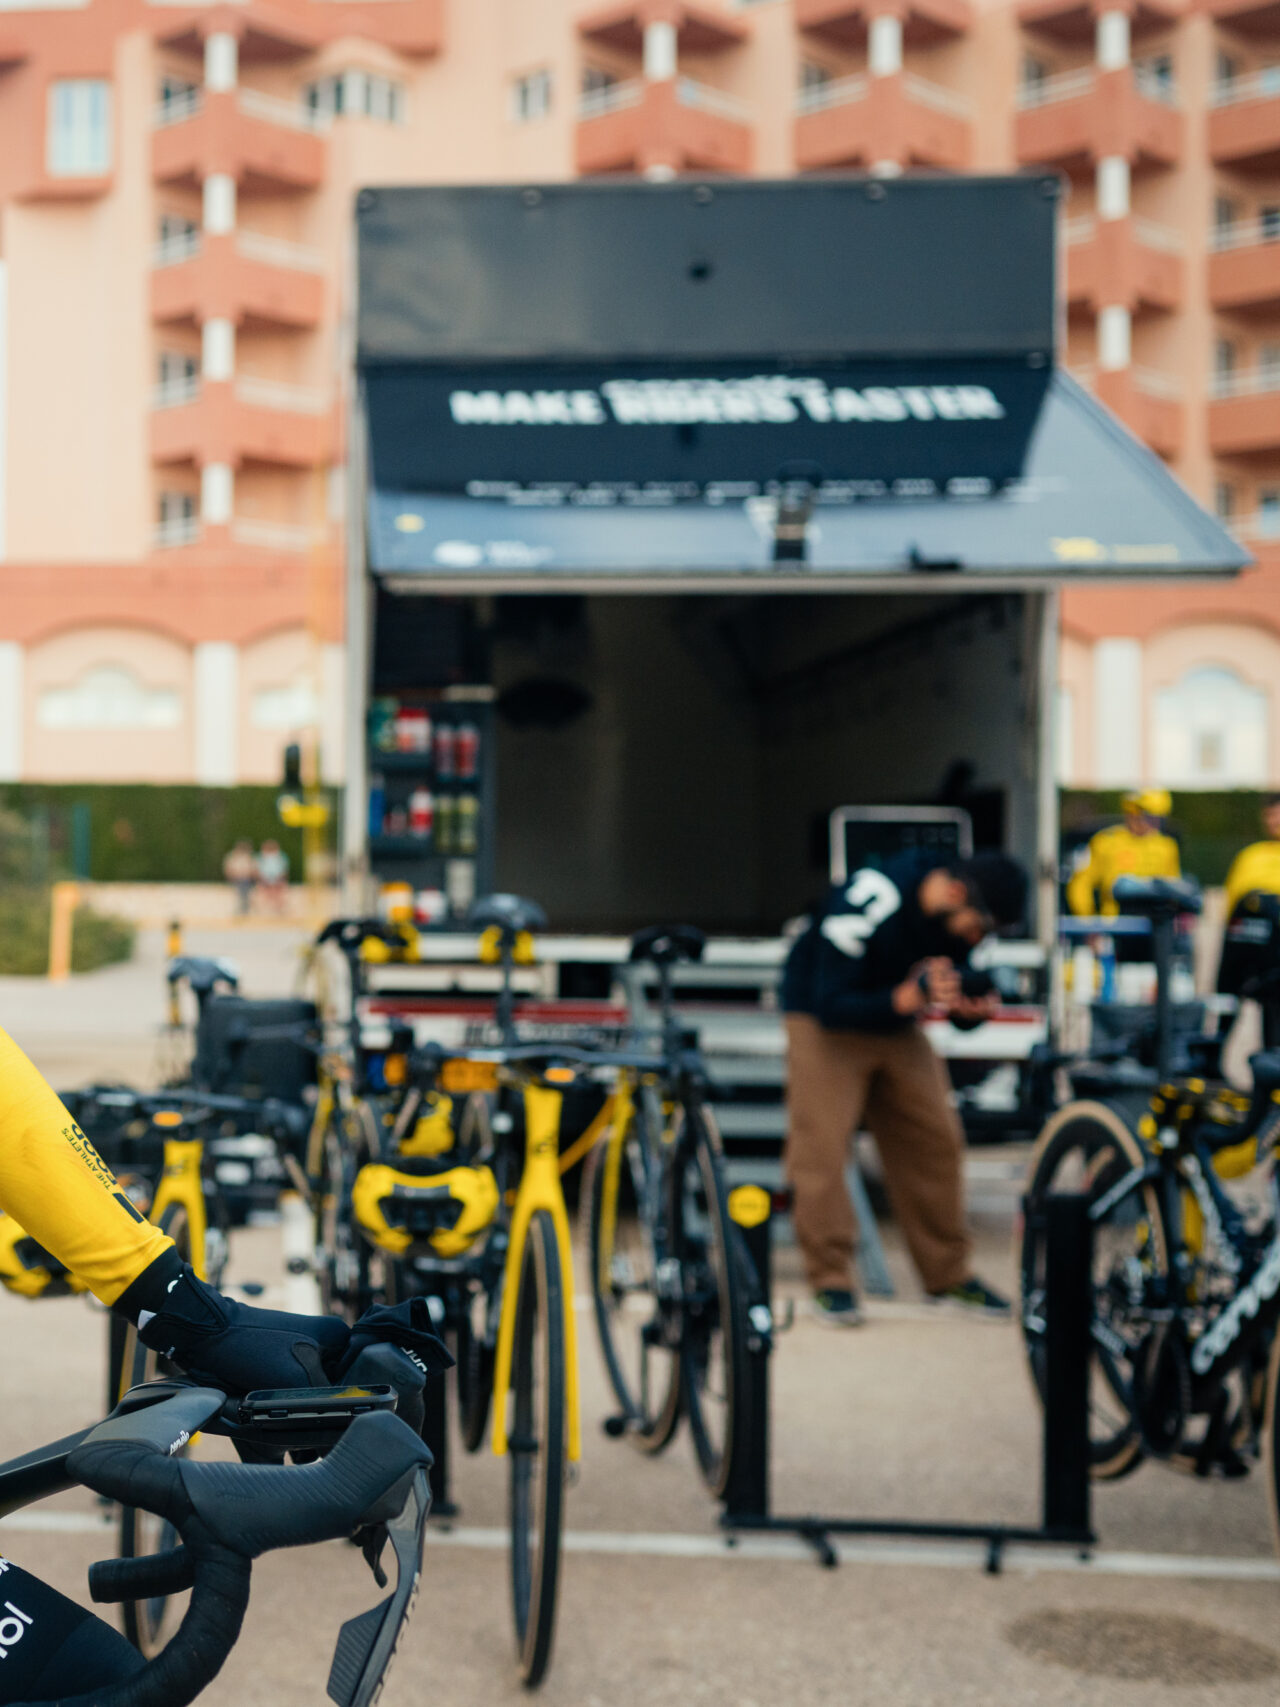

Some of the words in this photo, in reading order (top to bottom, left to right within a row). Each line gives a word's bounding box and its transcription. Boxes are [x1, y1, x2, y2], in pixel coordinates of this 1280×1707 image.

[449, 390, 606, 424] MAKE
[800, 384, 1006, 422] FASTER
[95, 1172, 111, 1190] THE
